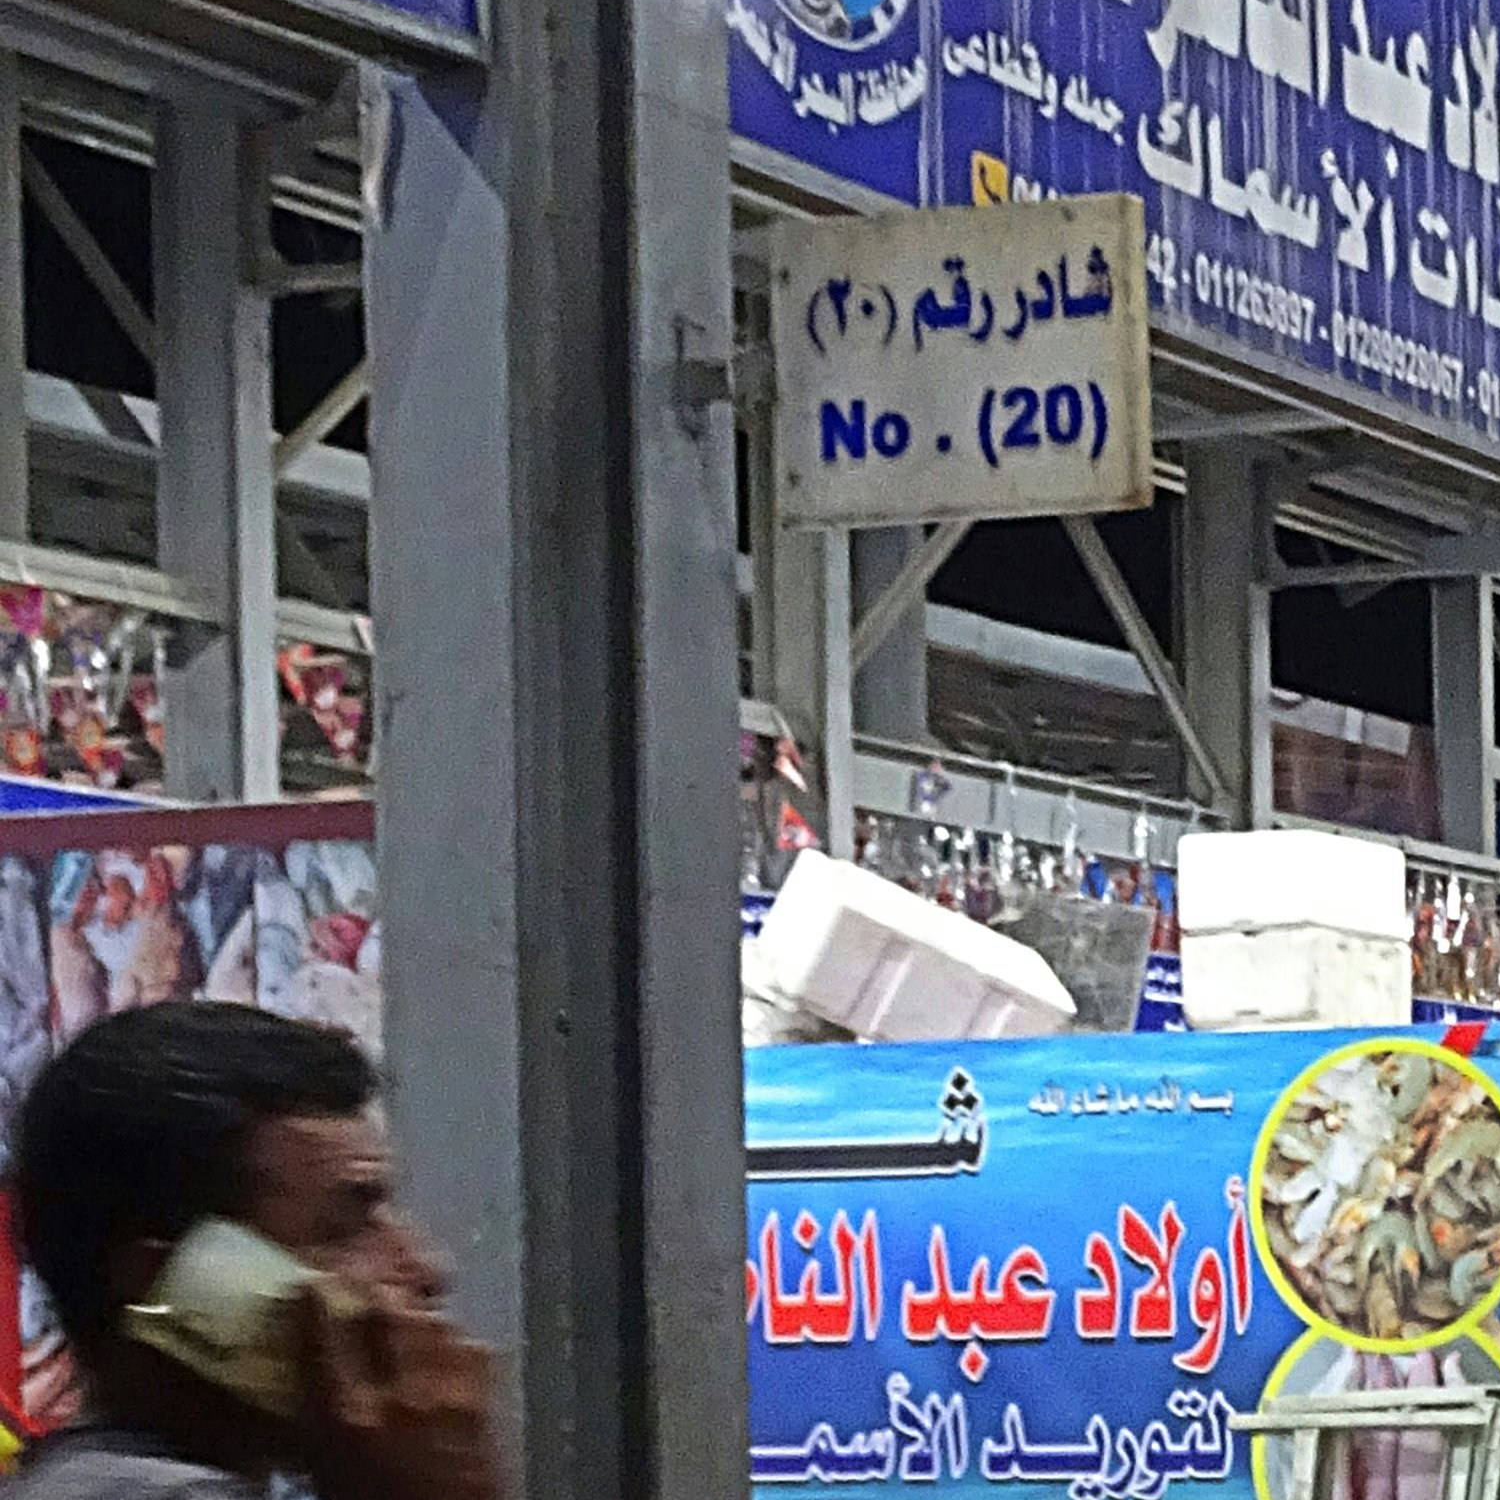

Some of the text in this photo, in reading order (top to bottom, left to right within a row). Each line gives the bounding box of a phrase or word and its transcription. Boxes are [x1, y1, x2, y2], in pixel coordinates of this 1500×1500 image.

[793, 69, 855, 138] البحر
[858, 53, 928, 126] محافظة
[1138, 100, 1396, 282] الأسماك
[805, 243, 1114, 358] شادر رقم (٢٠)
[978, 381, 1109, 469] (20)
[1028, 1074, 1234, 1117] بسم الله ما شاء الله
[902, 1221, 1057, 1383] عبد
[1073, 1174, 1255, 1375] أولاد
